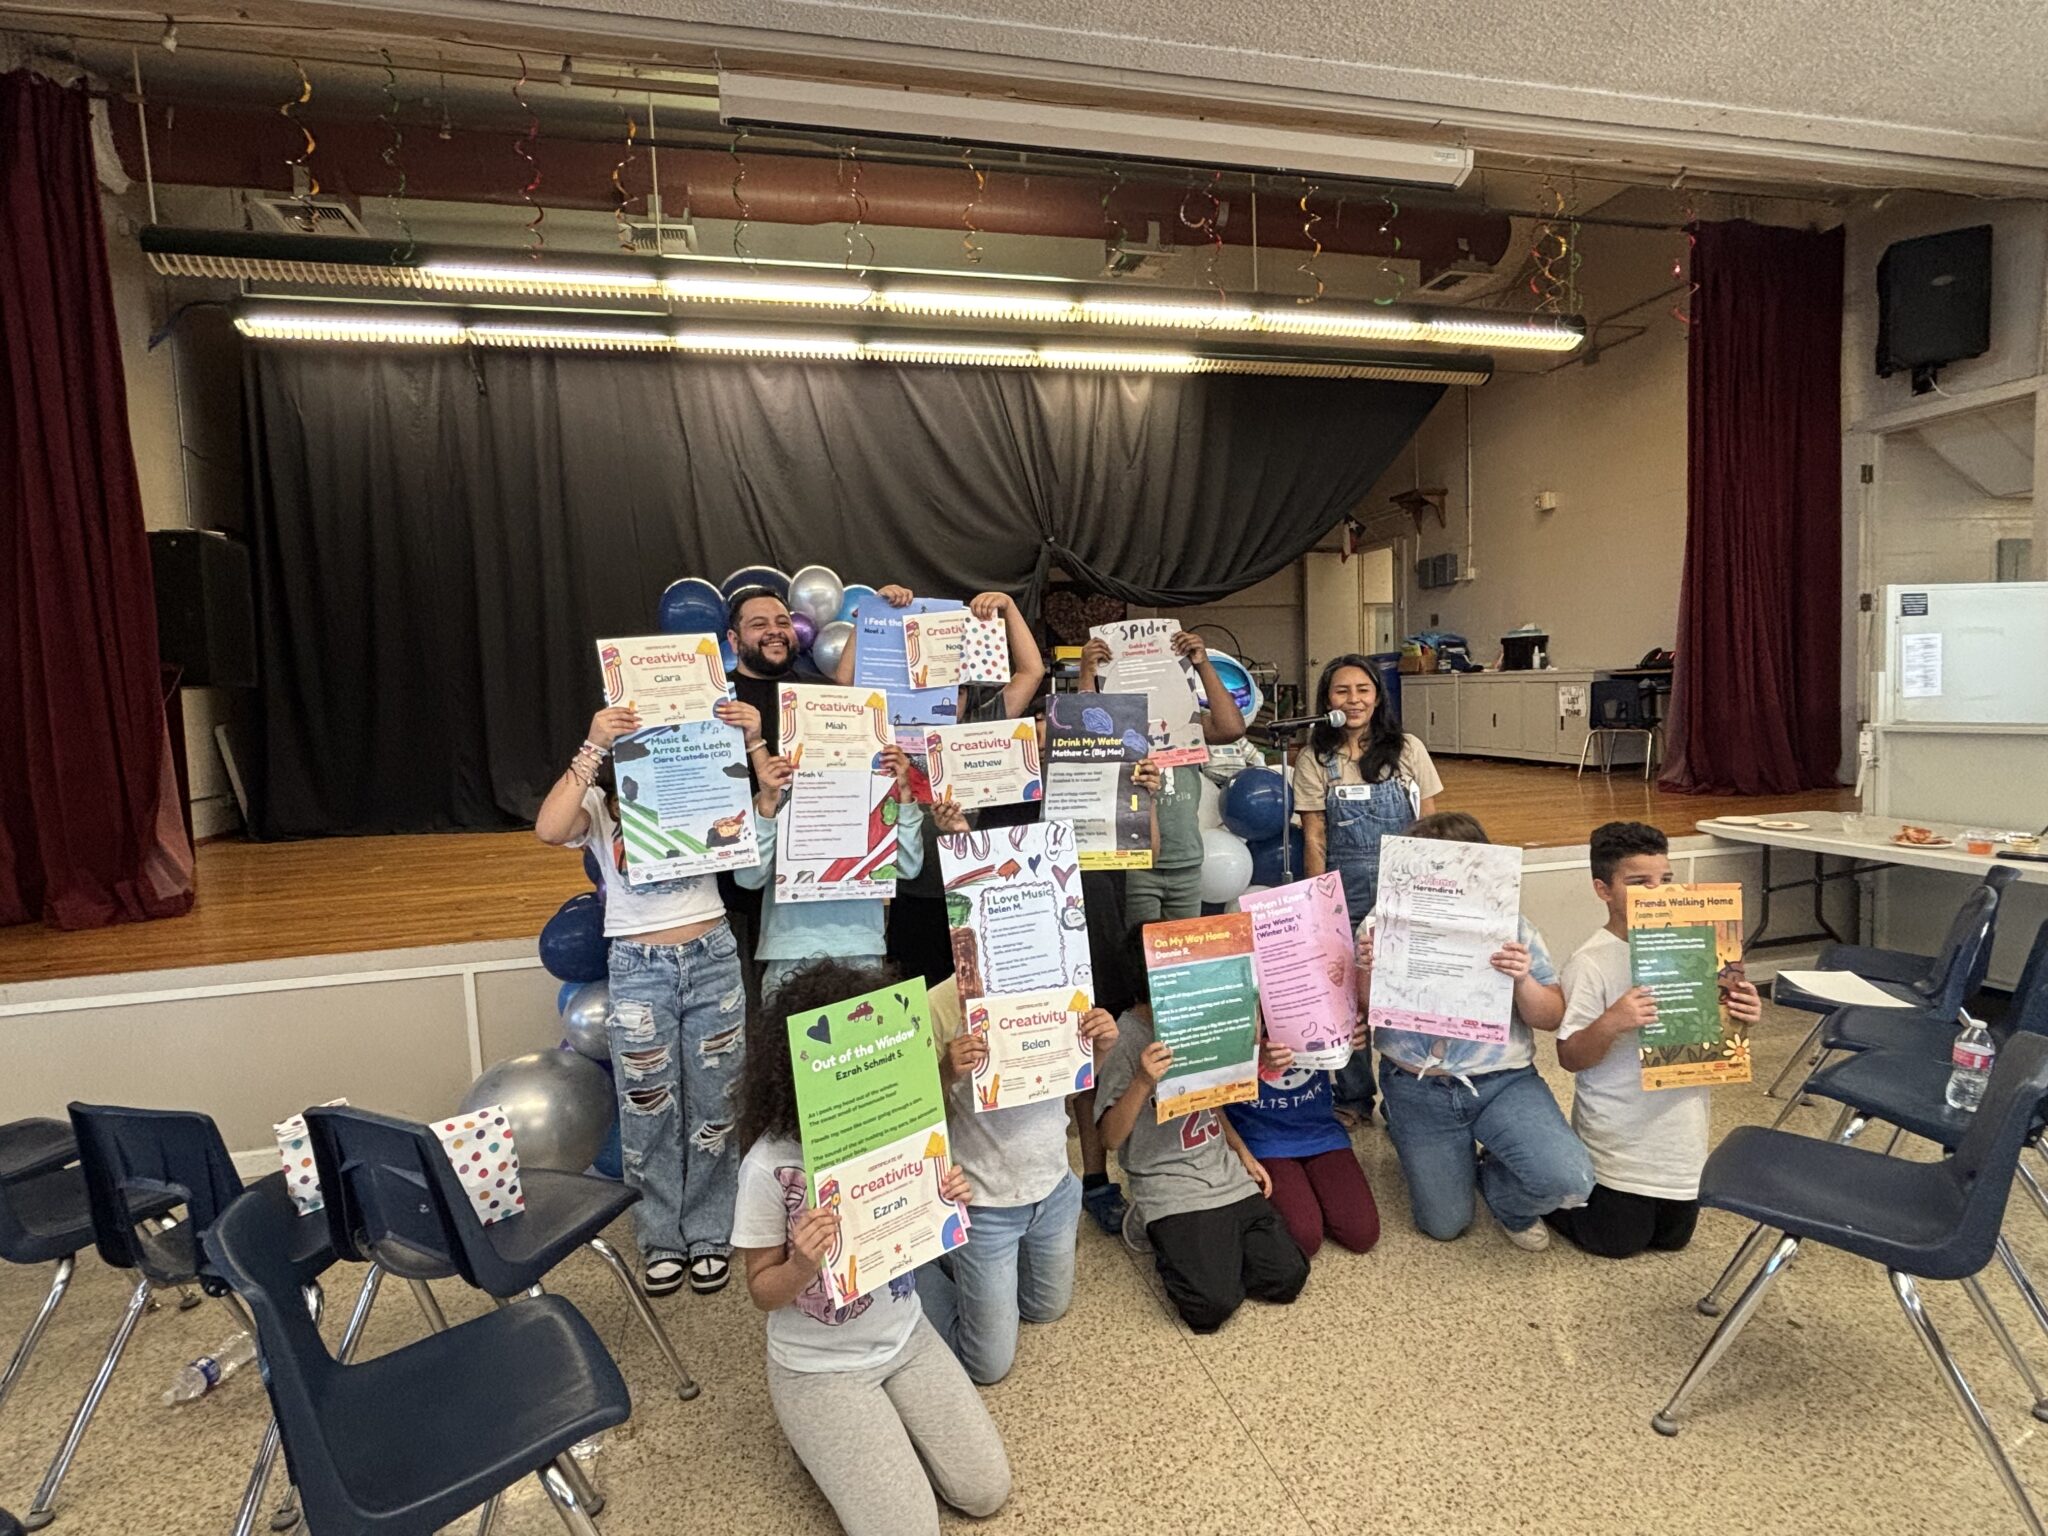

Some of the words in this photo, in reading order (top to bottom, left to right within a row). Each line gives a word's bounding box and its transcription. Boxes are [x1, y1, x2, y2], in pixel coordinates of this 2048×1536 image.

[869, 618, 886, 626] Feel
[927, 626, 964, 636] Creativ
[630, 652, 696, 668] Creativity
[654, 674, 681, 683] Ciara
[806, 701, 864, 715] Creativity
[826, 722, 847, 730] Miah
[651, 736, 678, 746] Music
[950, 738, 1011, 751] Creativity
[1053, 739, 1056, 747] I
[1057, 738, 1081, 747] Drink
[1082, 738, 1095, 748] My
[1098, 737, 1123, 746] Water
[653, 745, 681, 755] Arroz
[684, 744, 700, 752] con
[703, 740, 731, 750] Leche
[1092, 748, 1106, 758] (Big
[964, 760, 1002, 769] Mathew
[987, 896, 990, 905] I
[993, 894, 1019, 904] Love
[1022, 888, 1052, 900] Music
[1456, 888, 1465, 896] M.
[1635, 900, 1666, 908] Friends
[1669, 898, 1704, 908] Walking
[1707, 897, 1733, 905] Home
[988, 904, 1012, 915] Belen
[1255, 923, 1271, 931] Lucy
[1273, 916, 1294, 926] Winter
[1154, 939, 1168, 948] On
[1169, 937, 1183, 947] My
[1184, 934, 1204, 945] Way
[1205, 931, 1230, 940] Home
[1256, 930, 1282, 941] (Winter
[1000, 1010, 1067, 1030] Creativity
[812, 1057, 836, 1072] Out
[839, 1051, 852, 1064] of
[854, 1043, 874, 1058] the
[875, 1028, 915, 1050] Window
[1022, 1039, 1050, 1051] Belen
[836, 1066, 862, 1081] Ezrah
[864, 1053, 896, 1071] Schmidt
[897, 1049, 904, 1059] S.
[850, 1159, 924, 1200] Creativity
[873, 1196, 908, 1220] Ezrah
